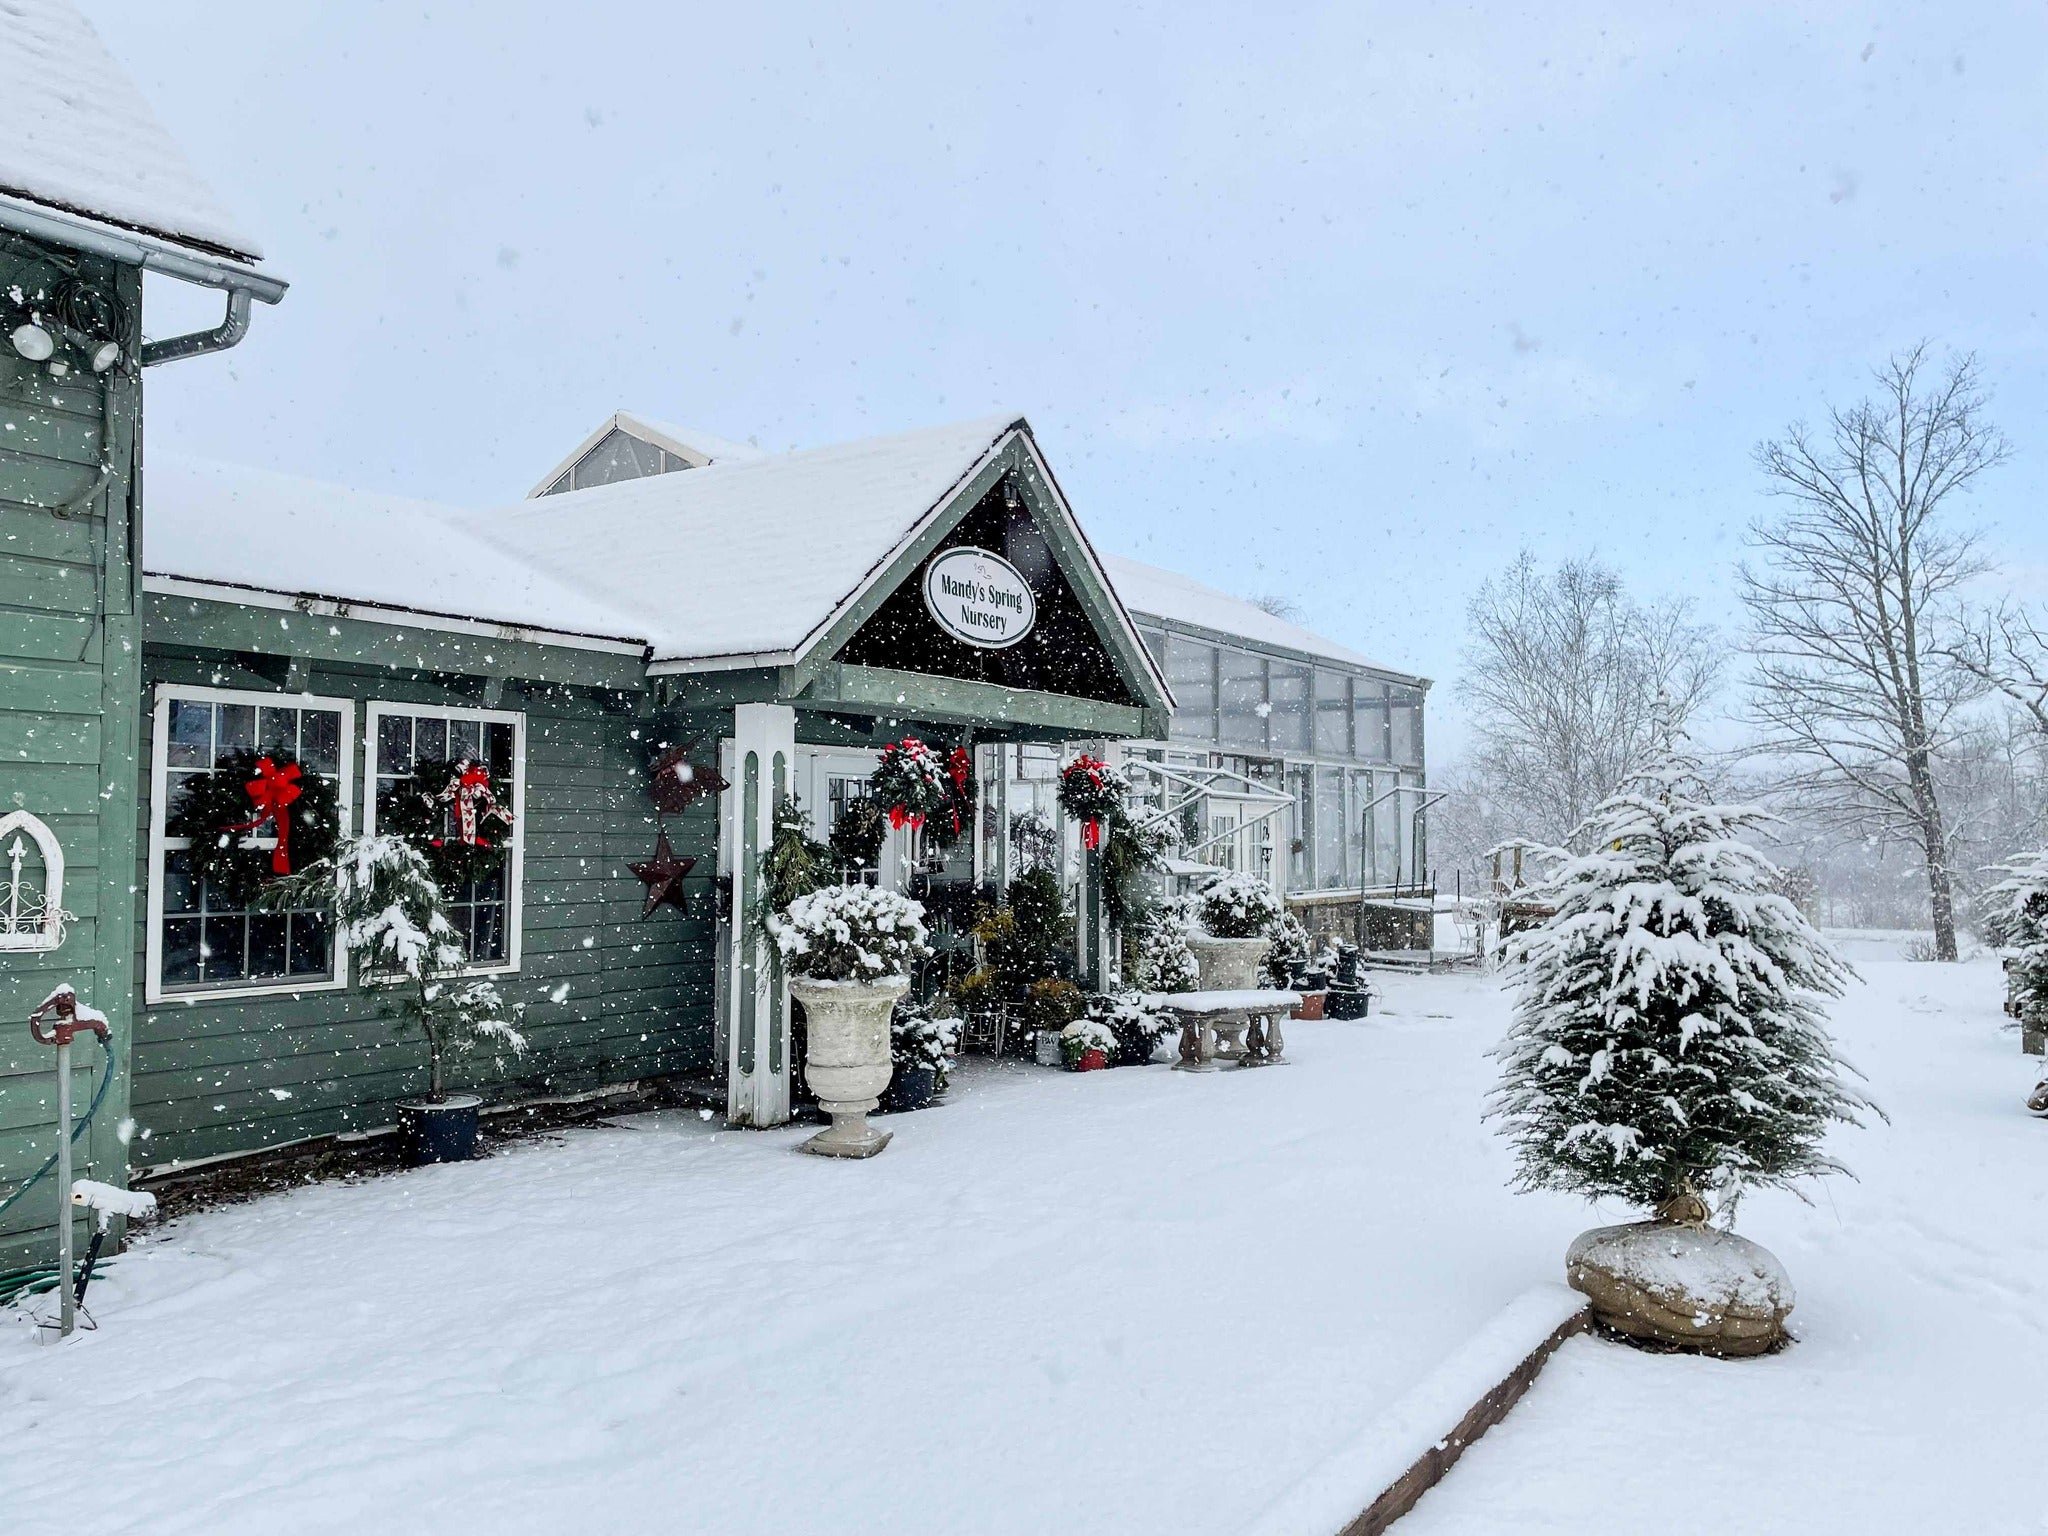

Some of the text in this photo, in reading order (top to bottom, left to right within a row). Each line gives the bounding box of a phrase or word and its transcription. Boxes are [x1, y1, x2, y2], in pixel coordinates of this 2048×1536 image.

[941, 574, 1022, 614] Mandy's Spring
[961, 605, 1007, 635] Nursery
